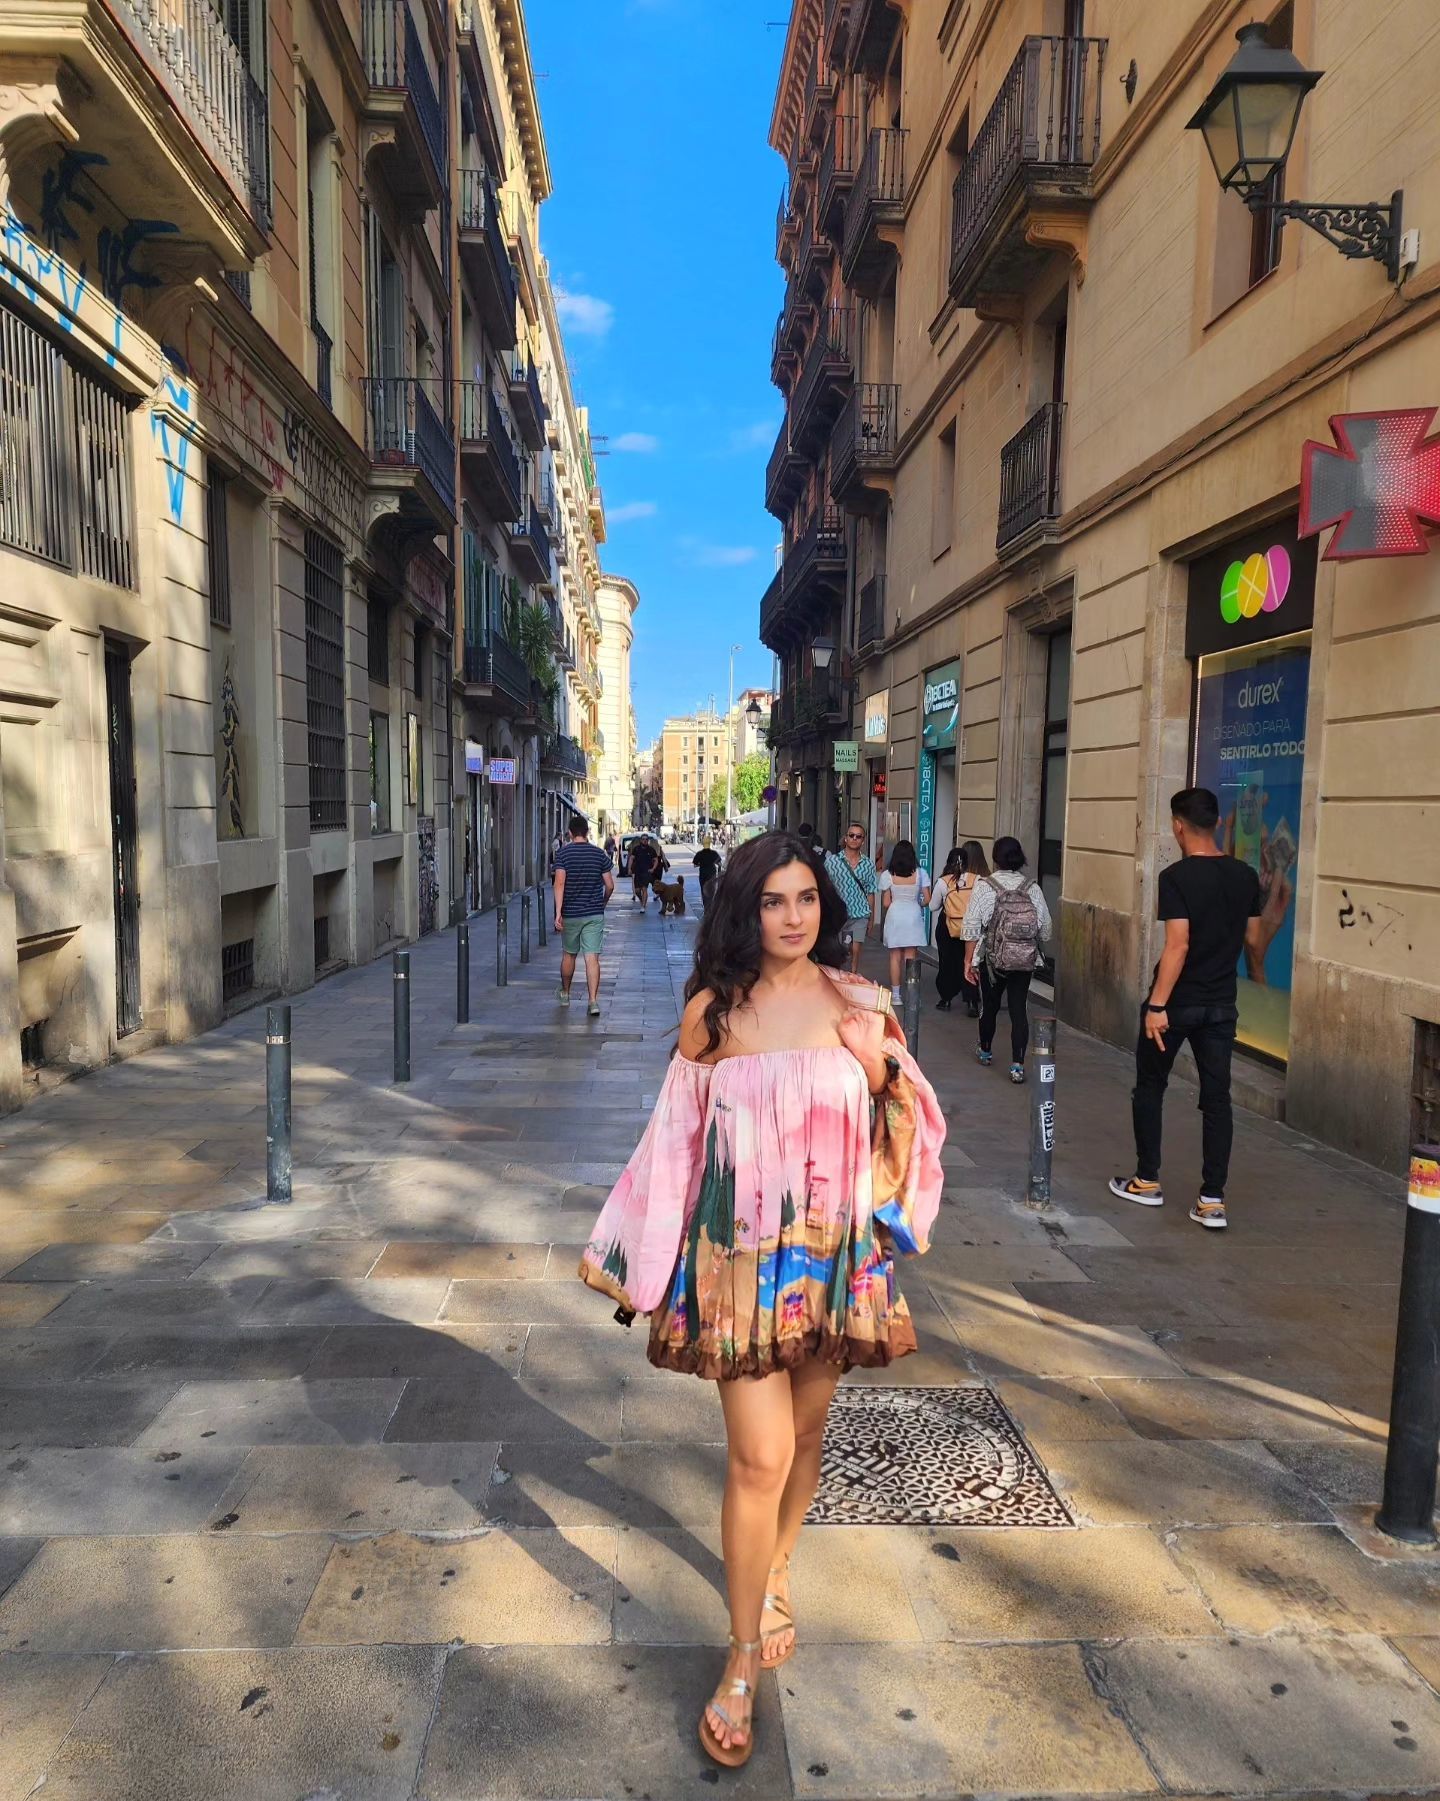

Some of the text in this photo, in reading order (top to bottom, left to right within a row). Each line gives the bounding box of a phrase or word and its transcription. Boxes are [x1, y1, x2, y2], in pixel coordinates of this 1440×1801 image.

[1238, 676, 1283, 708] durex
[1262, 718, 1291, 734] PARA
[1220, 740, 1305, 760] SENTIRLO TODO
[490, 760, 514, 772] SUPER
[920, 829, 929, 867] 18CTE
